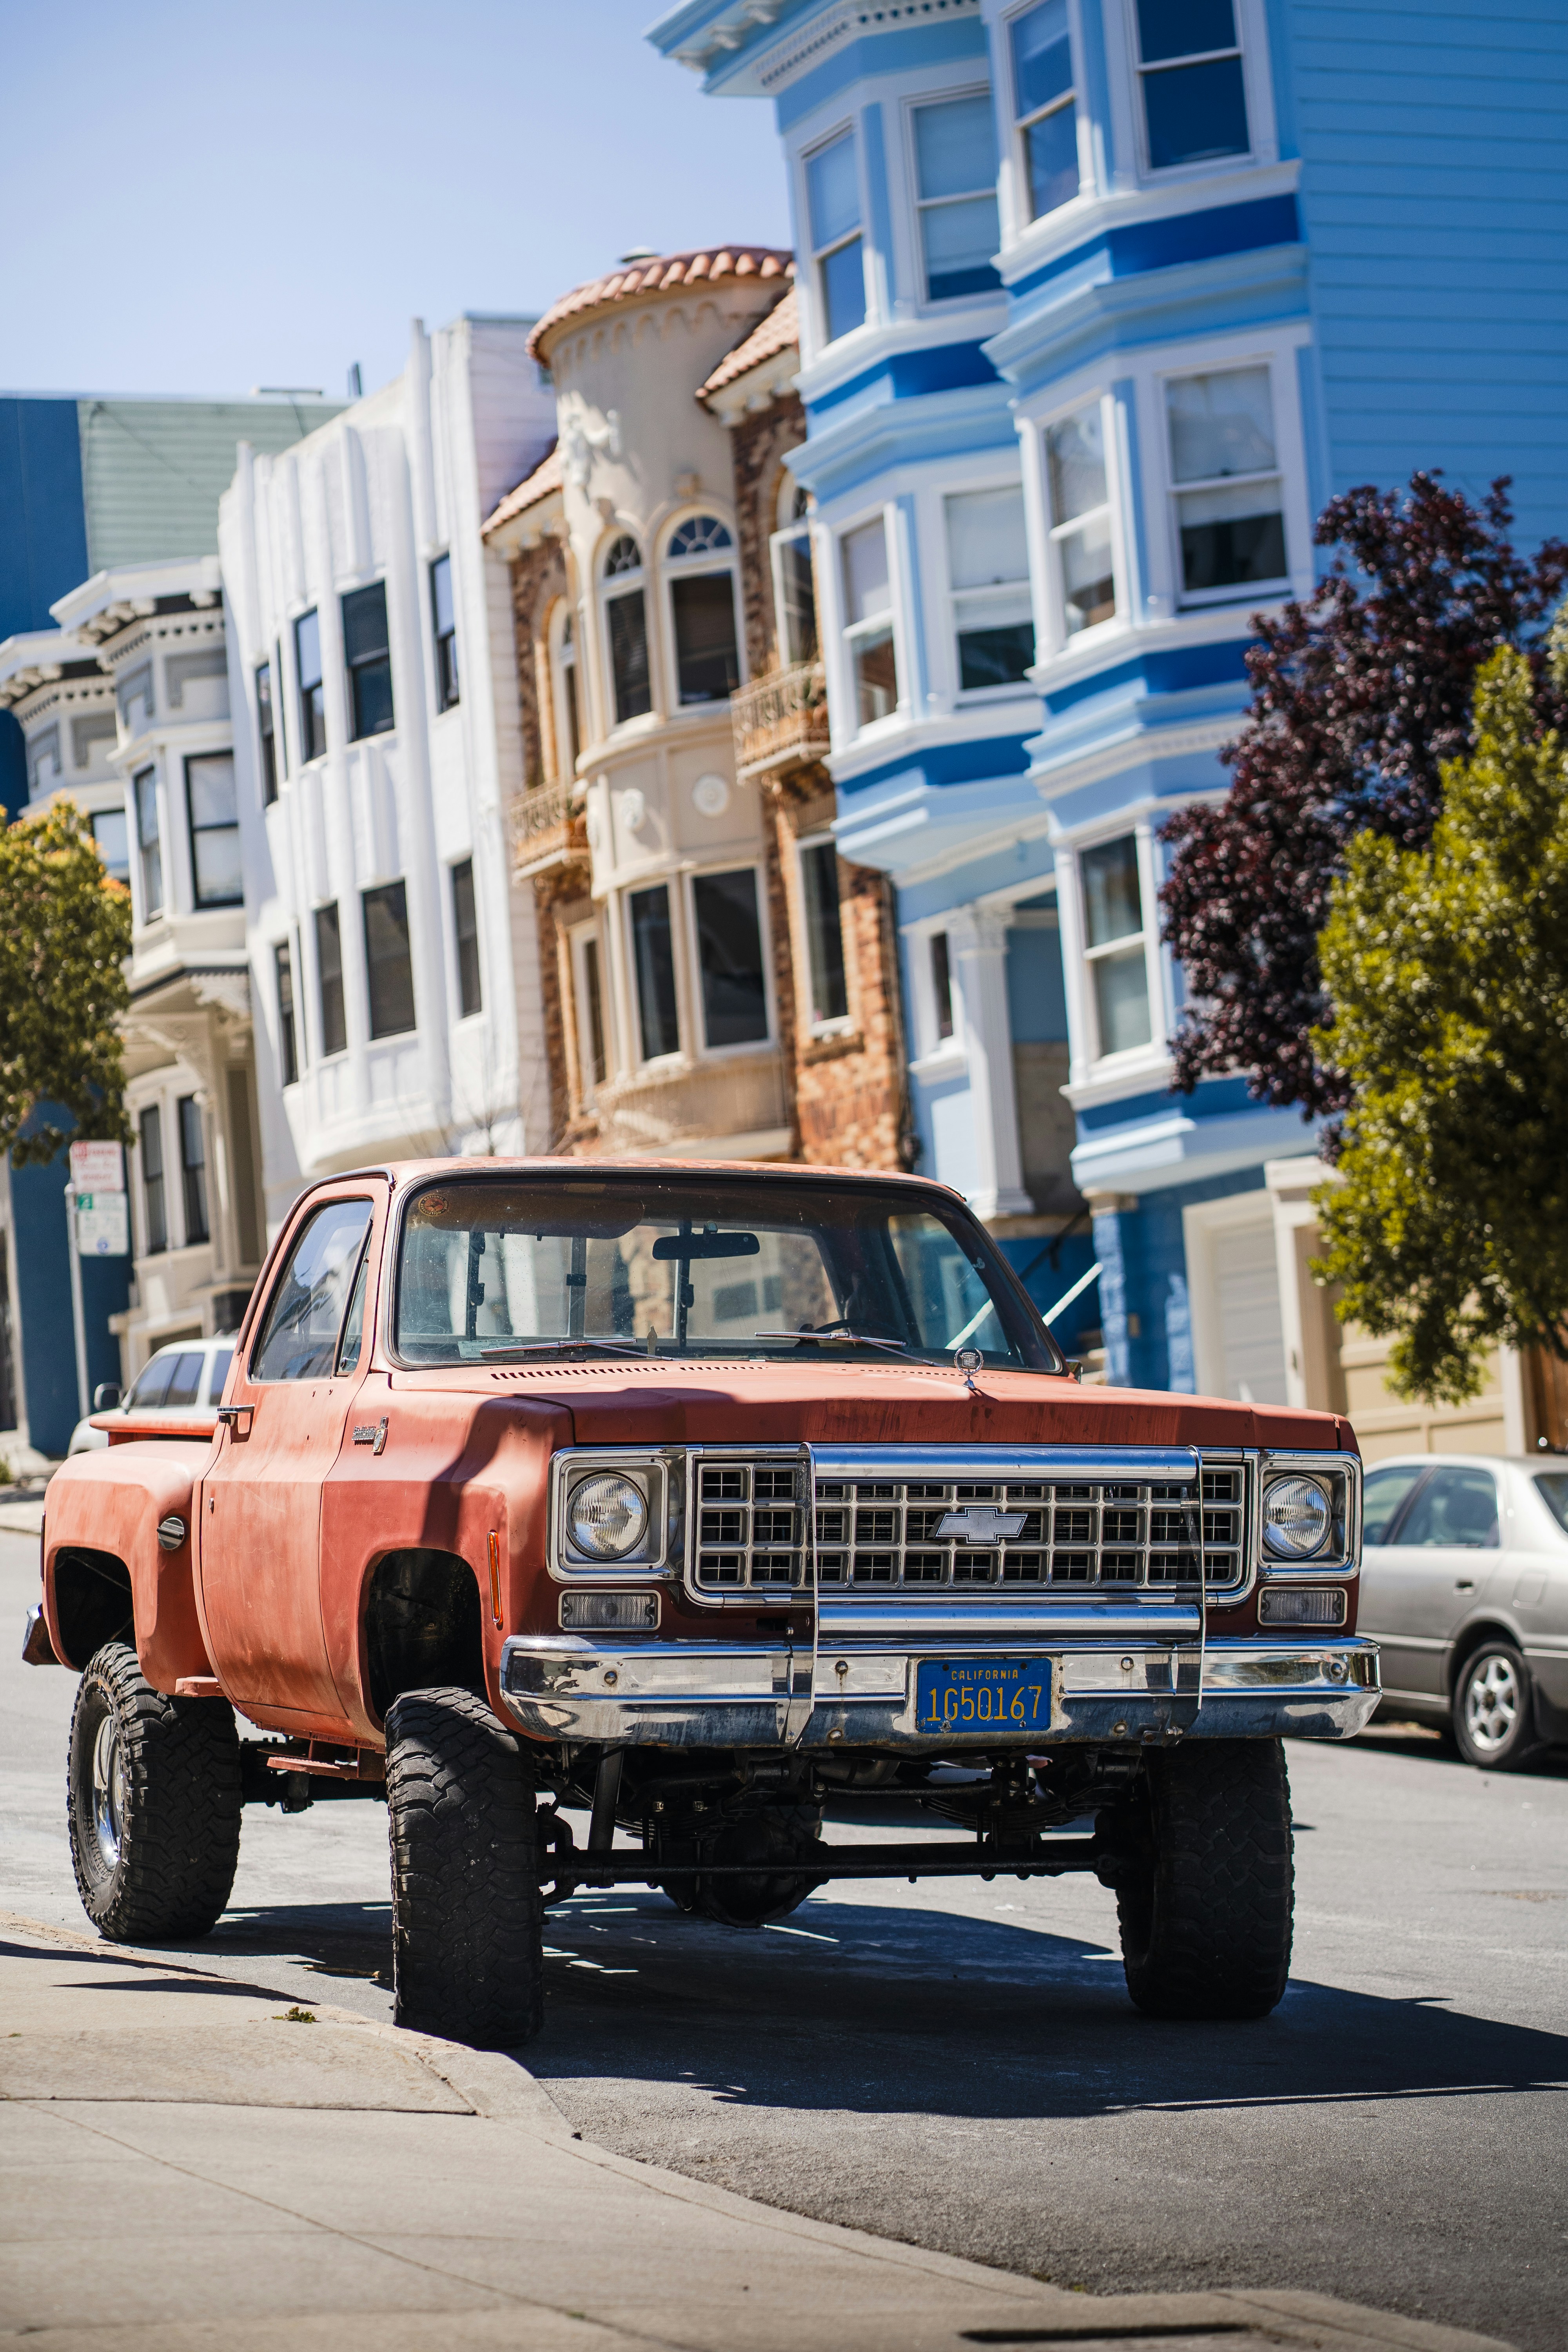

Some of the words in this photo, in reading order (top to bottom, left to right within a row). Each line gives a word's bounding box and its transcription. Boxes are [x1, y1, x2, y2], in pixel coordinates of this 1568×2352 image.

[421, 1203, 441, 1215] ASSOCIATION
[951, 1669, 1018, 1681] CALIFORNIA
[927, 1686, 1042, 1721] 1G50167
